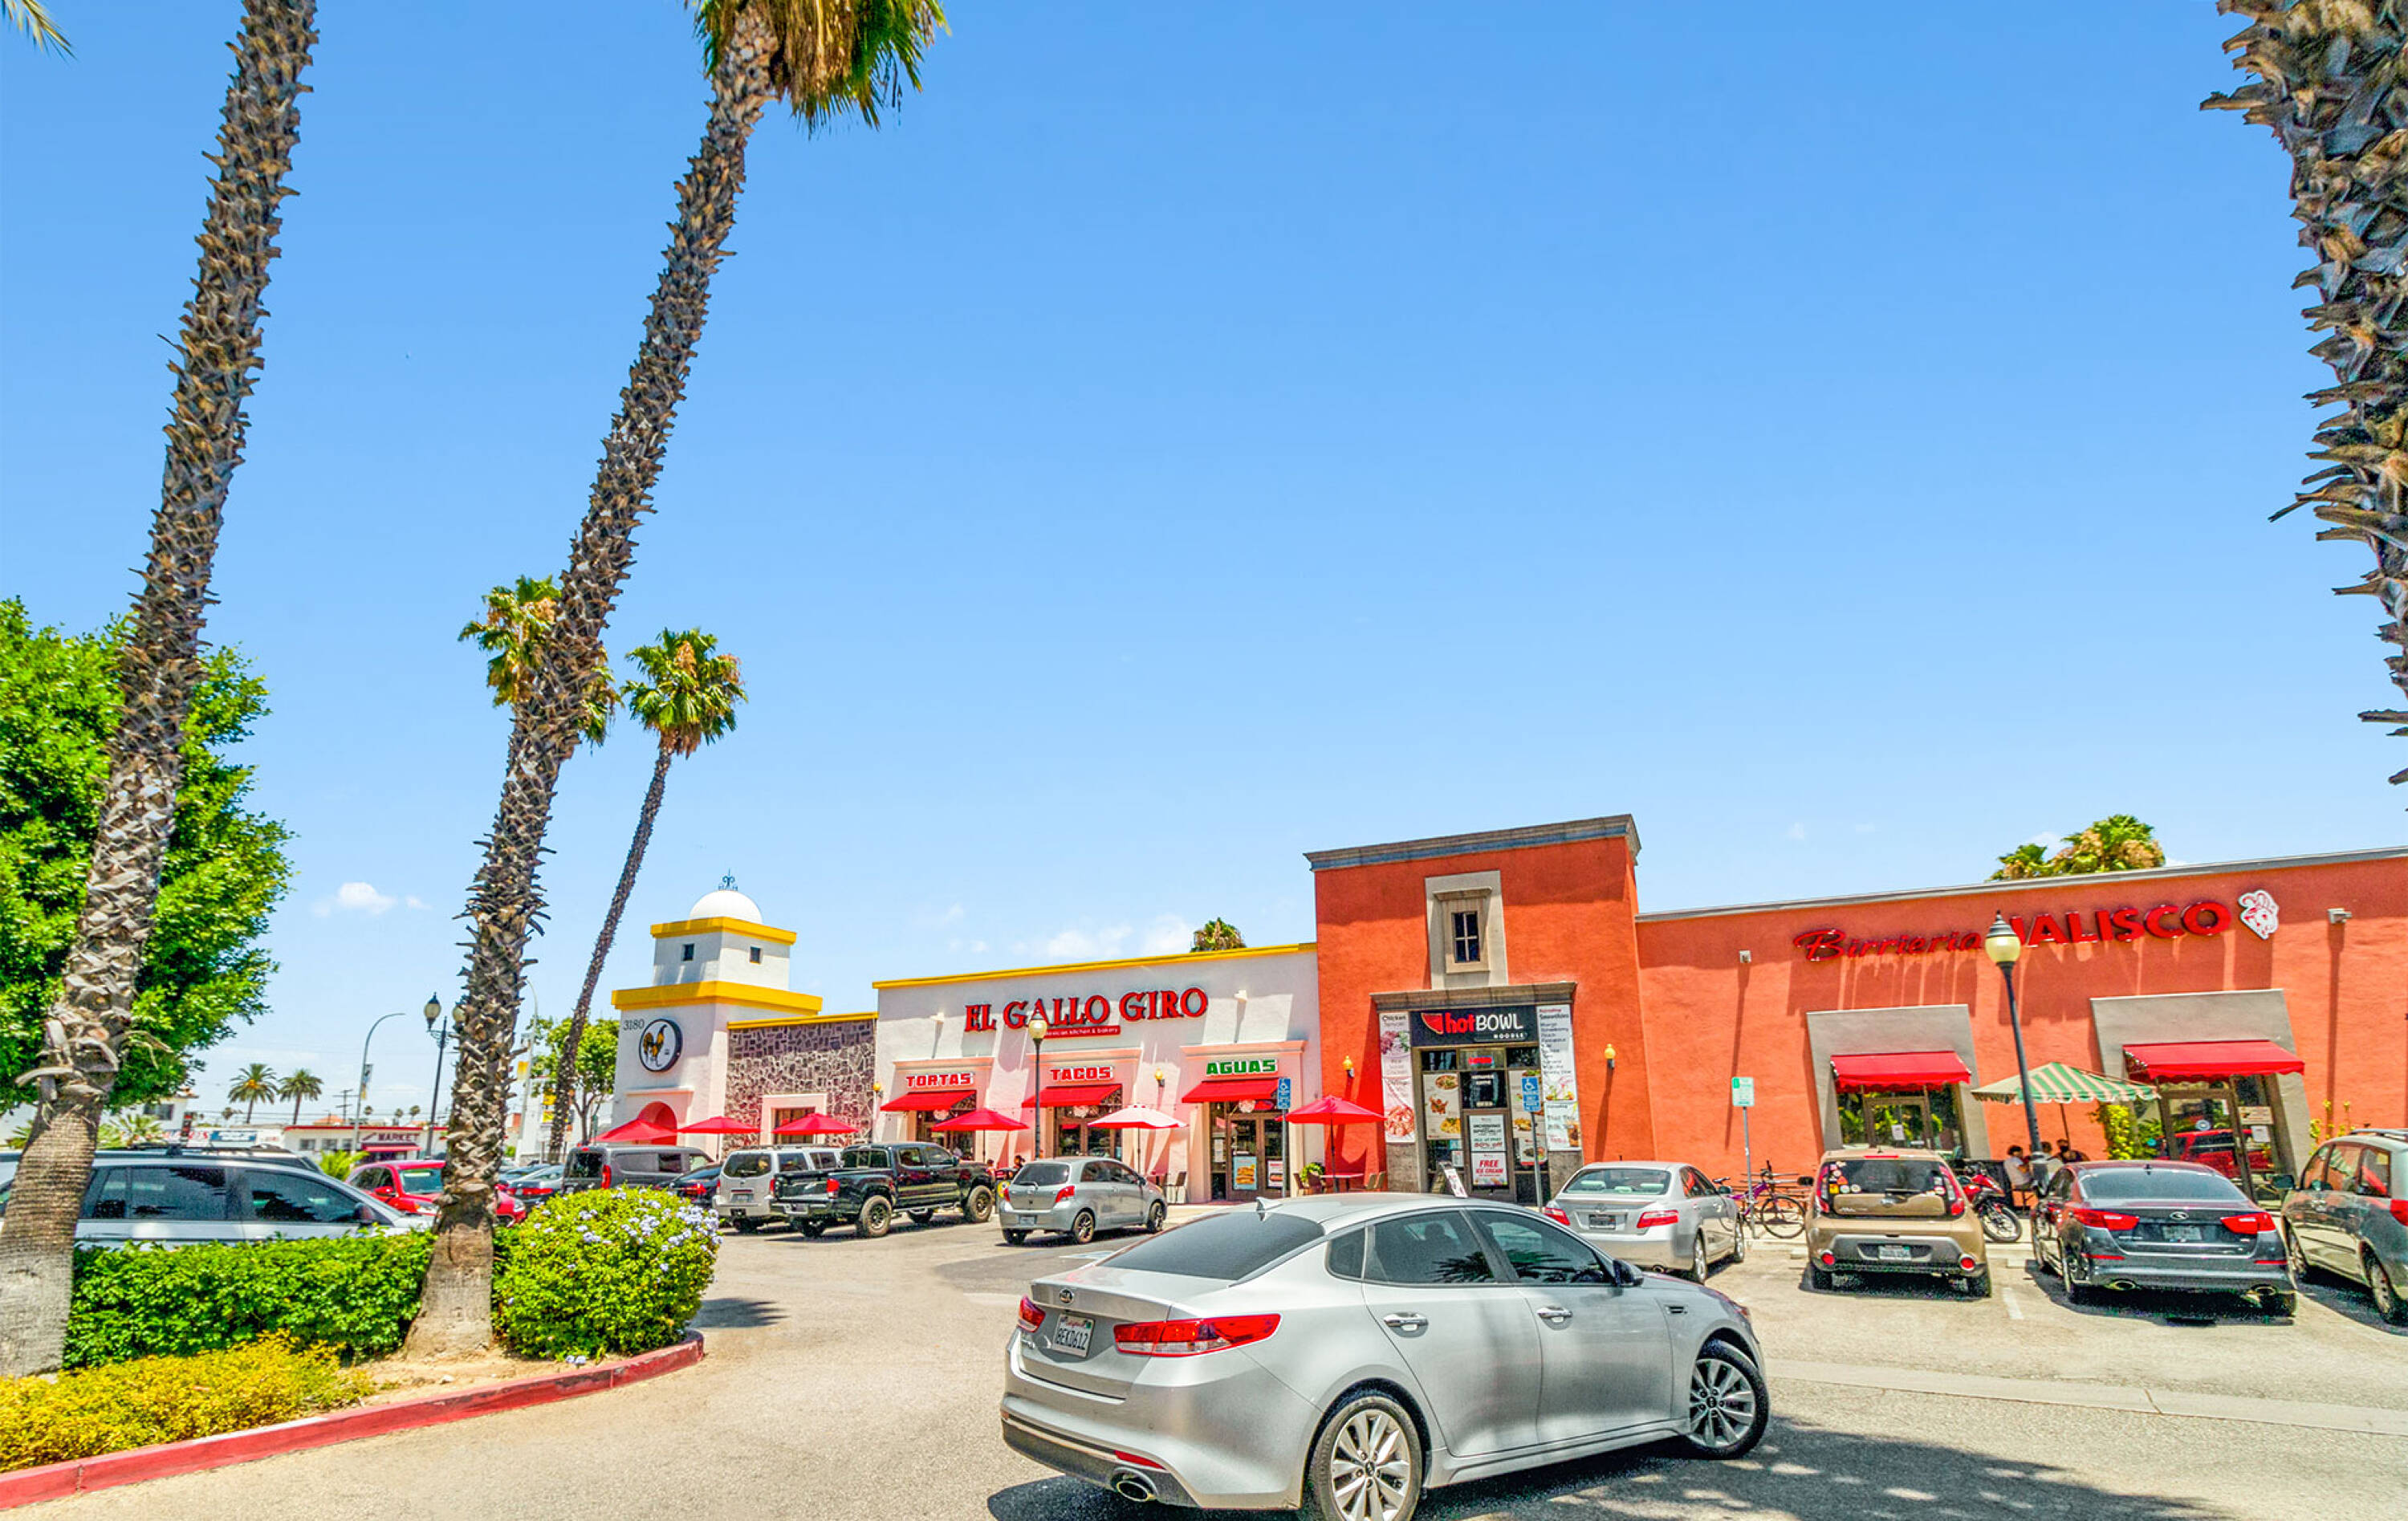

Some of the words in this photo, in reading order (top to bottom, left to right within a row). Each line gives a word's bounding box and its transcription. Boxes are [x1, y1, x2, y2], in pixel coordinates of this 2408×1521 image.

[1793, 929, 1984, 962] Birrieria
[965, 1004, 996, 1031] EL
[1003, 995, 1110, 1029] GALLO
[1119, 987, 1208, 1021] GIRO
[623, 1019, 645, 1031] 3180
[1050, 1067, 1113, 1080] TACOS
[1206, 1059, 1276, 1075] AGUAS
[906, 1073, 974, 1087] TORTAS
[378, 1133, 420, 1141] MARKET
[1479, 1160, 1499, 1168] FREE
